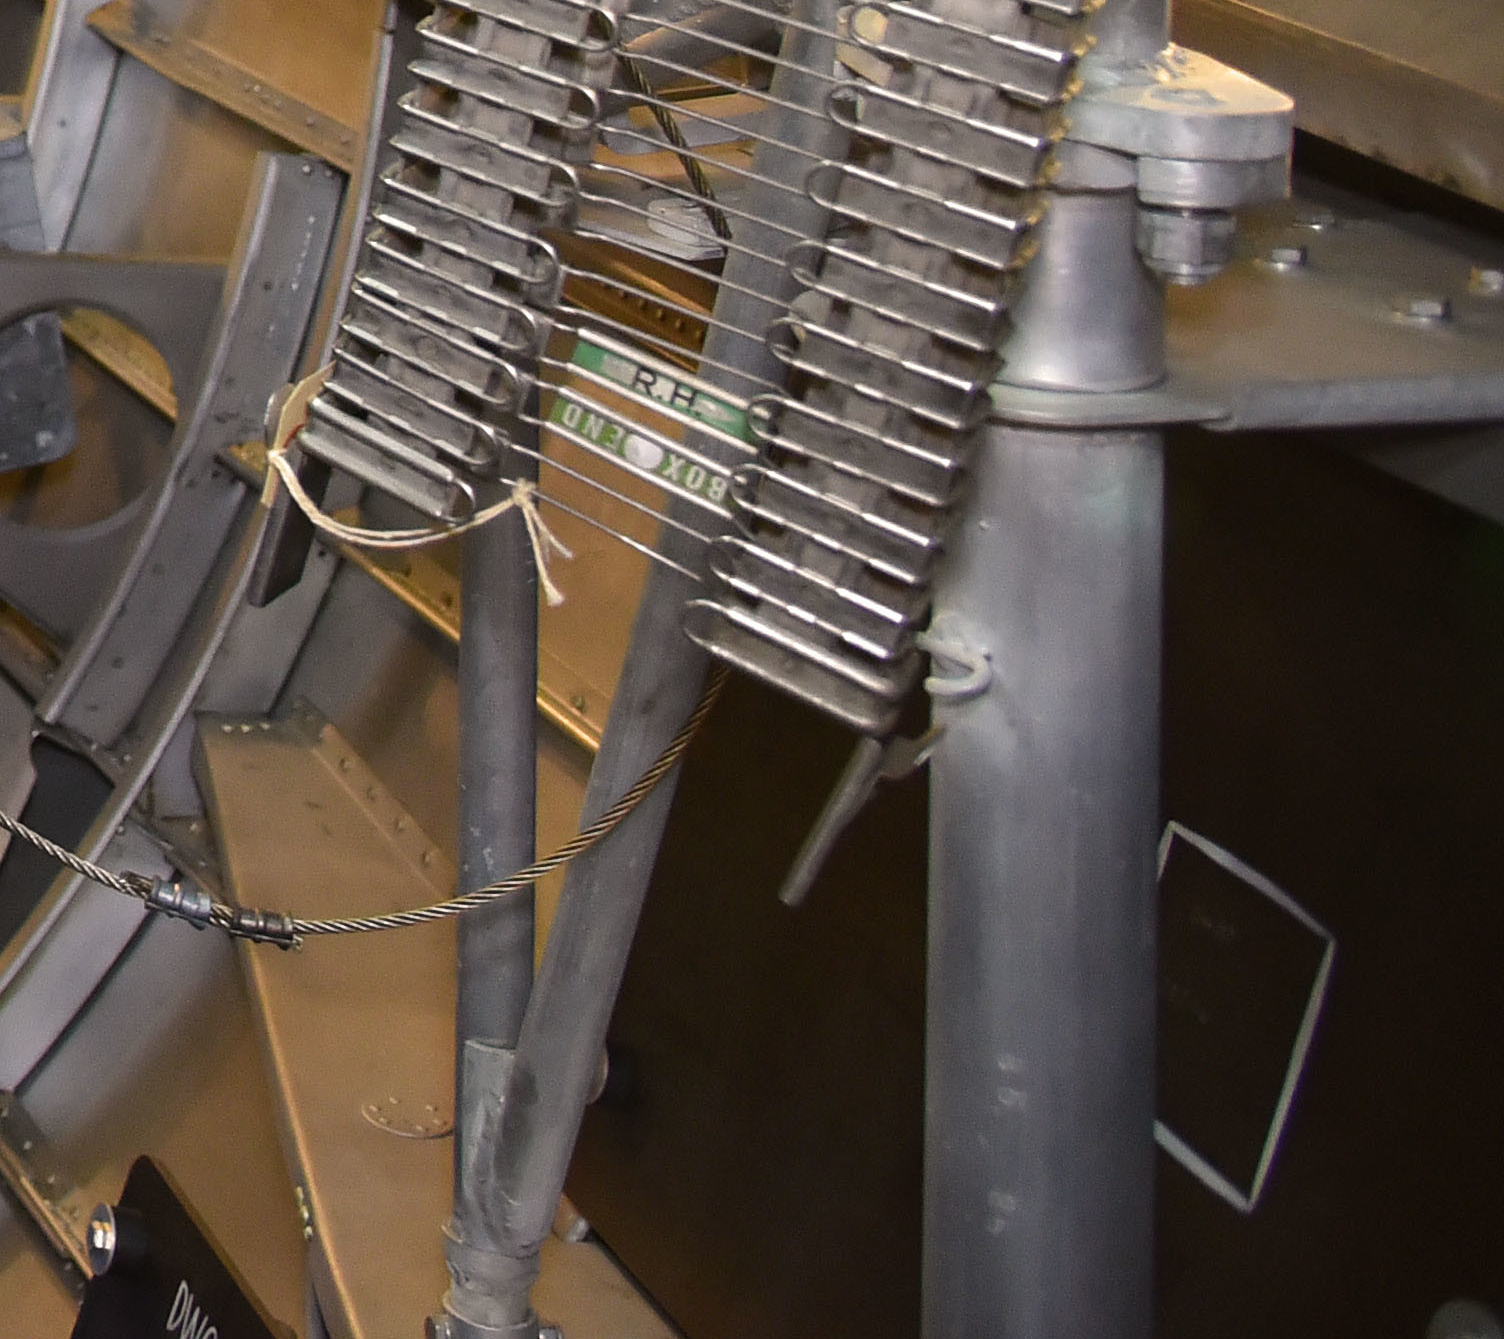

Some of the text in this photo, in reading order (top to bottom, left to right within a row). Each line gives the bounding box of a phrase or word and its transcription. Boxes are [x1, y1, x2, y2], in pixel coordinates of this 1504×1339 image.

[632, 366, 706, 415] R.H.
[561, 403, 729, 504] BOX END
[166, 1279, 219, 1339] DW
